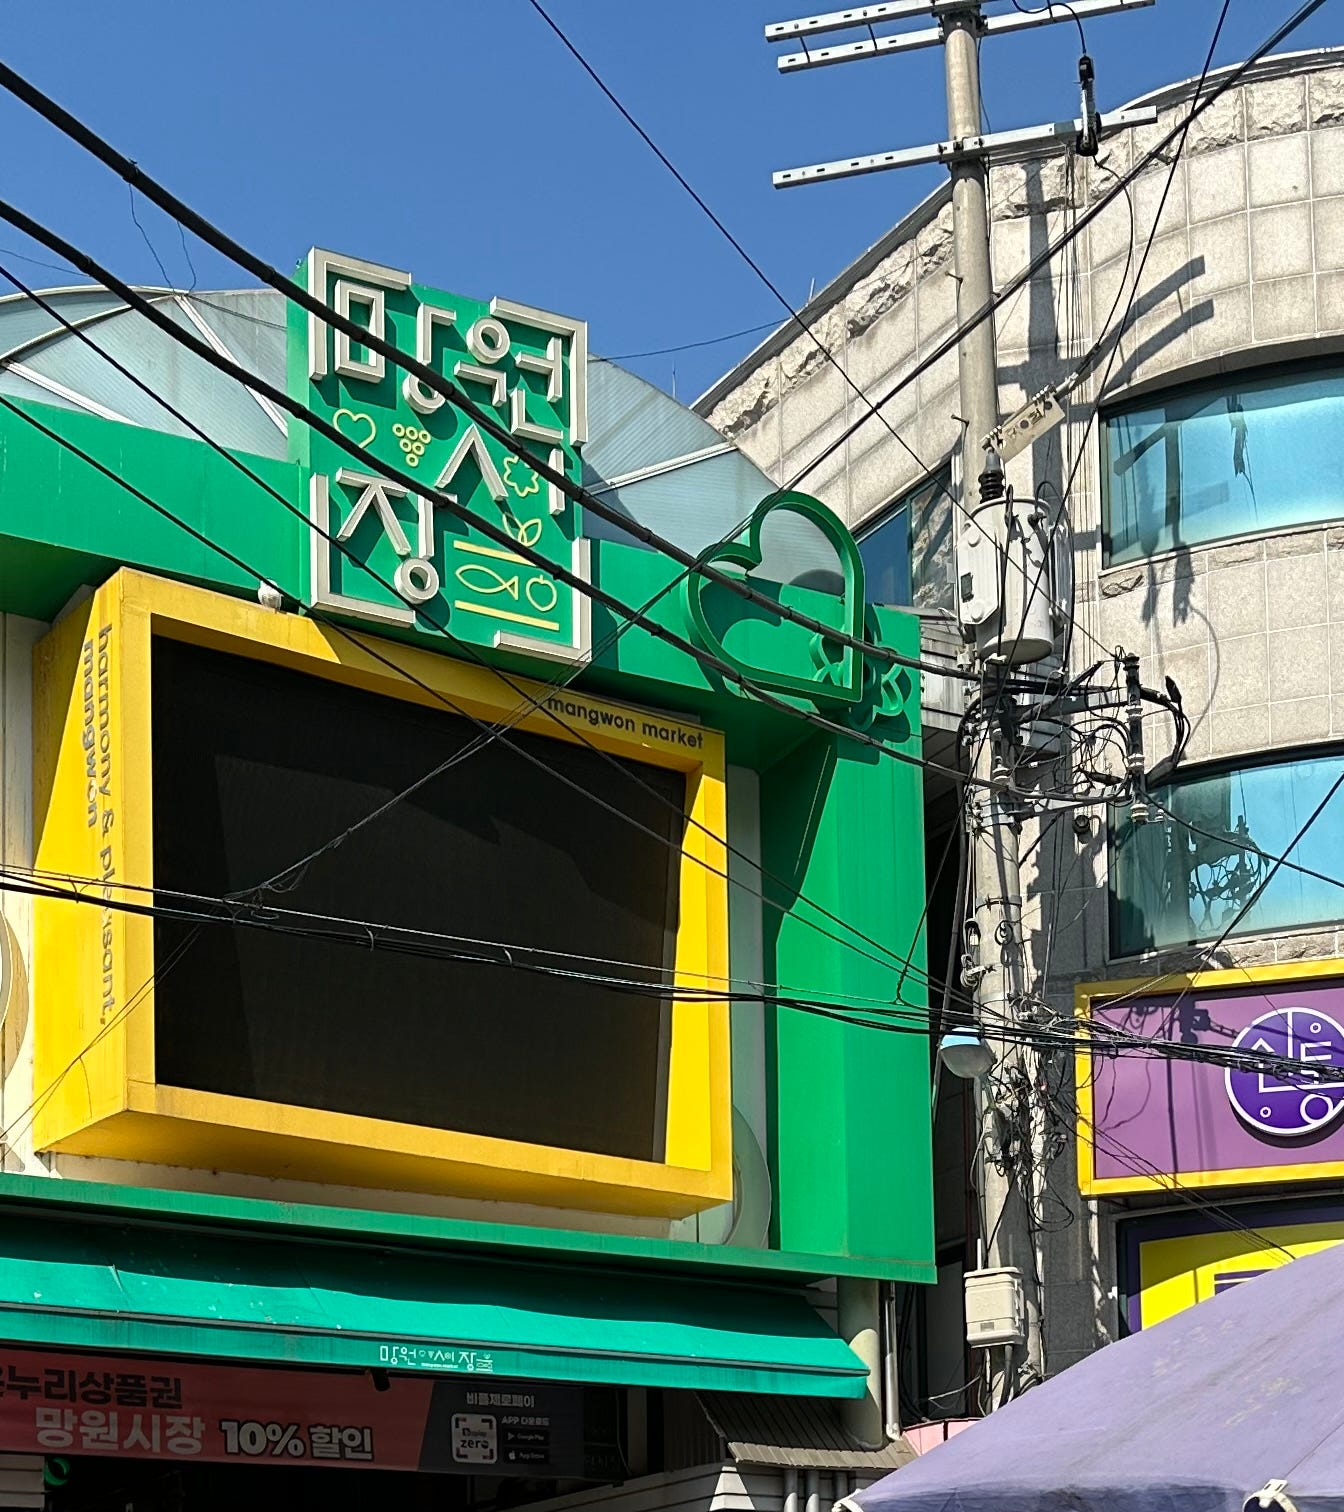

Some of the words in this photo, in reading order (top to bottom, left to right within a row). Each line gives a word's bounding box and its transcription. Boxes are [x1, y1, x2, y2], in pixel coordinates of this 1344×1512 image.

[82, 639, 100, 828] mangwon
[98, 623, 113, 797] harmony
[548, 698, 636, 733] mangwon
[642, 721, 704, 749] market
[99, 845, 115, 1026] plesant.
[35, 1407, 205, 1455] 망원시장
[219, 1420, 305, 1457] 10%
[309, 1425, 374, 1461] 할인
